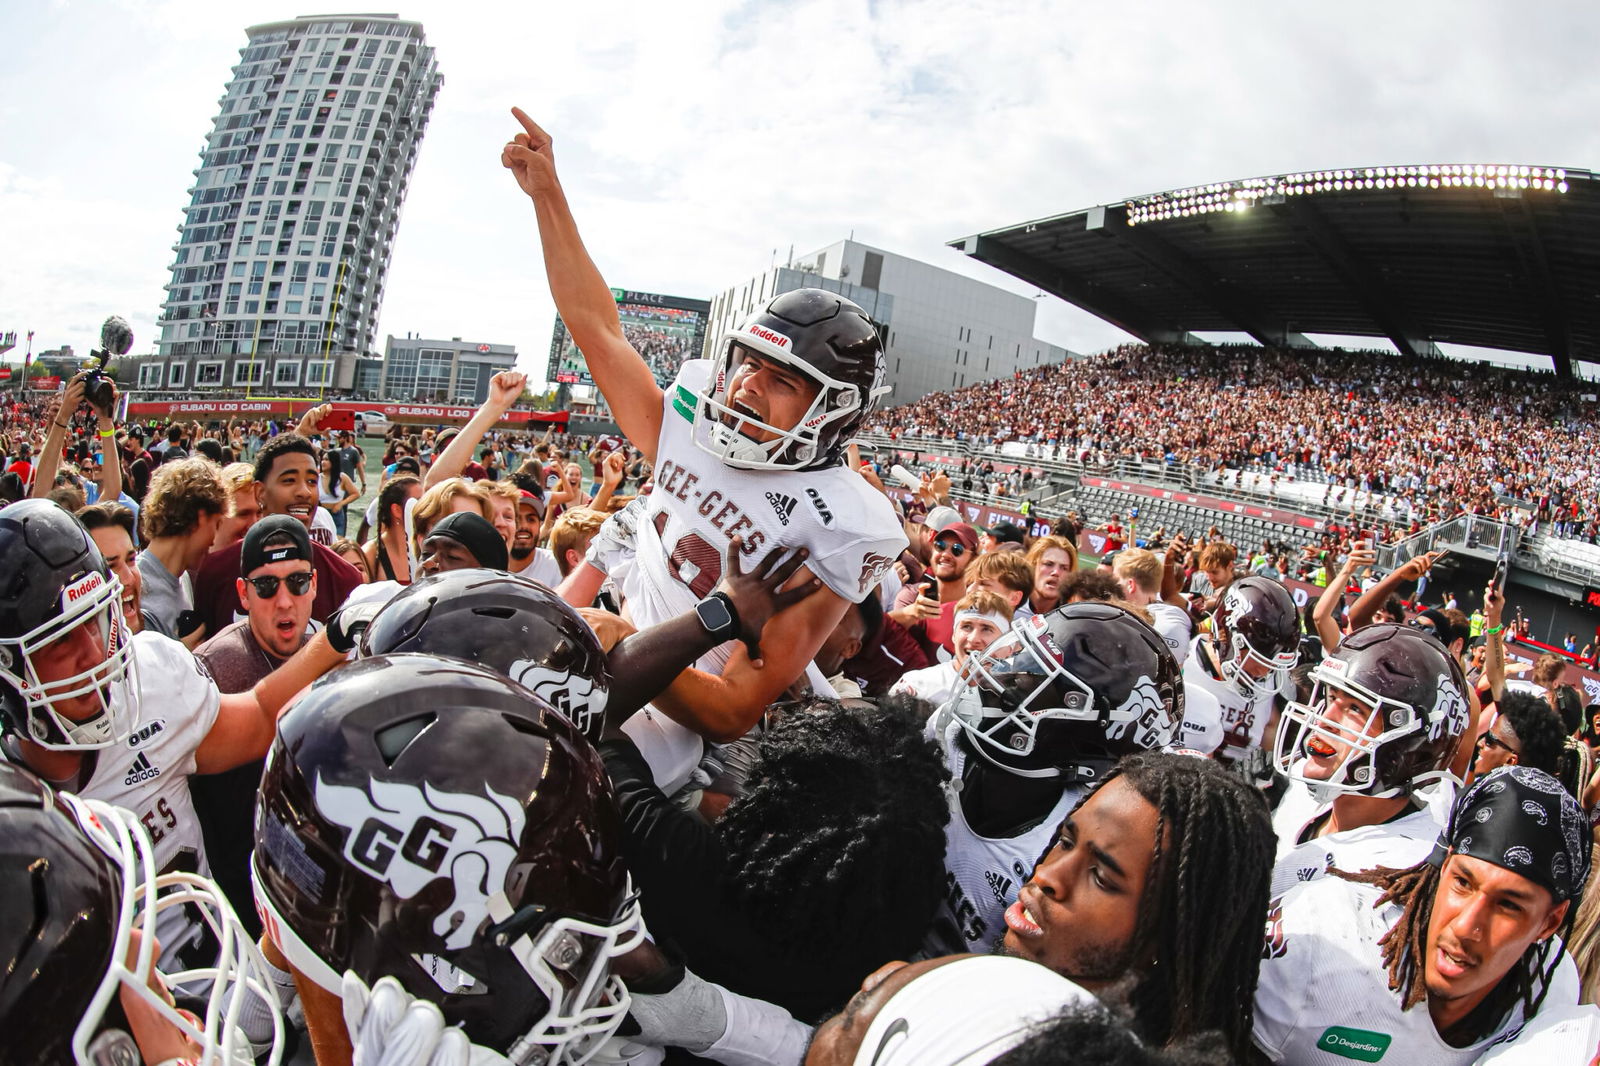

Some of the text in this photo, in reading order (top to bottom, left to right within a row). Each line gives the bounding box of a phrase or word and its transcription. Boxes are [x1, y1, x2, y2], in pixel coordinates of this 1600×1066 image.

[626, 291, 664, 304] PLACE
[750, 325, 788, 347] Riddell
[180, 402, 272, 412] SUBARU LOG CABIN
[398, 406, 444, 416] SUBARU
[447, 408, 470, 418] LOG
[658, 460, 765, 555] GEE-GEES
[765, 491, 790, 527] adidas
[805, 488, 835, 526] OUA
[67, 575, 102, 602] Riddell
[107, 618, 118, 659] Riddell
[550, 688, 589, 734] GG
[1449, 699, 1464, 735] GG
[128, 721, 163, 747] OUA
[1139, 707, 1161, 748] GG
[1183, 721, 1206, 733] OUA
[124, 767, 160, 786] adidas
[140, 797, 177, 846] ES
[352, 815, 457, 876] GG
[1338, 1038, 1379, 1053] Desjardins
